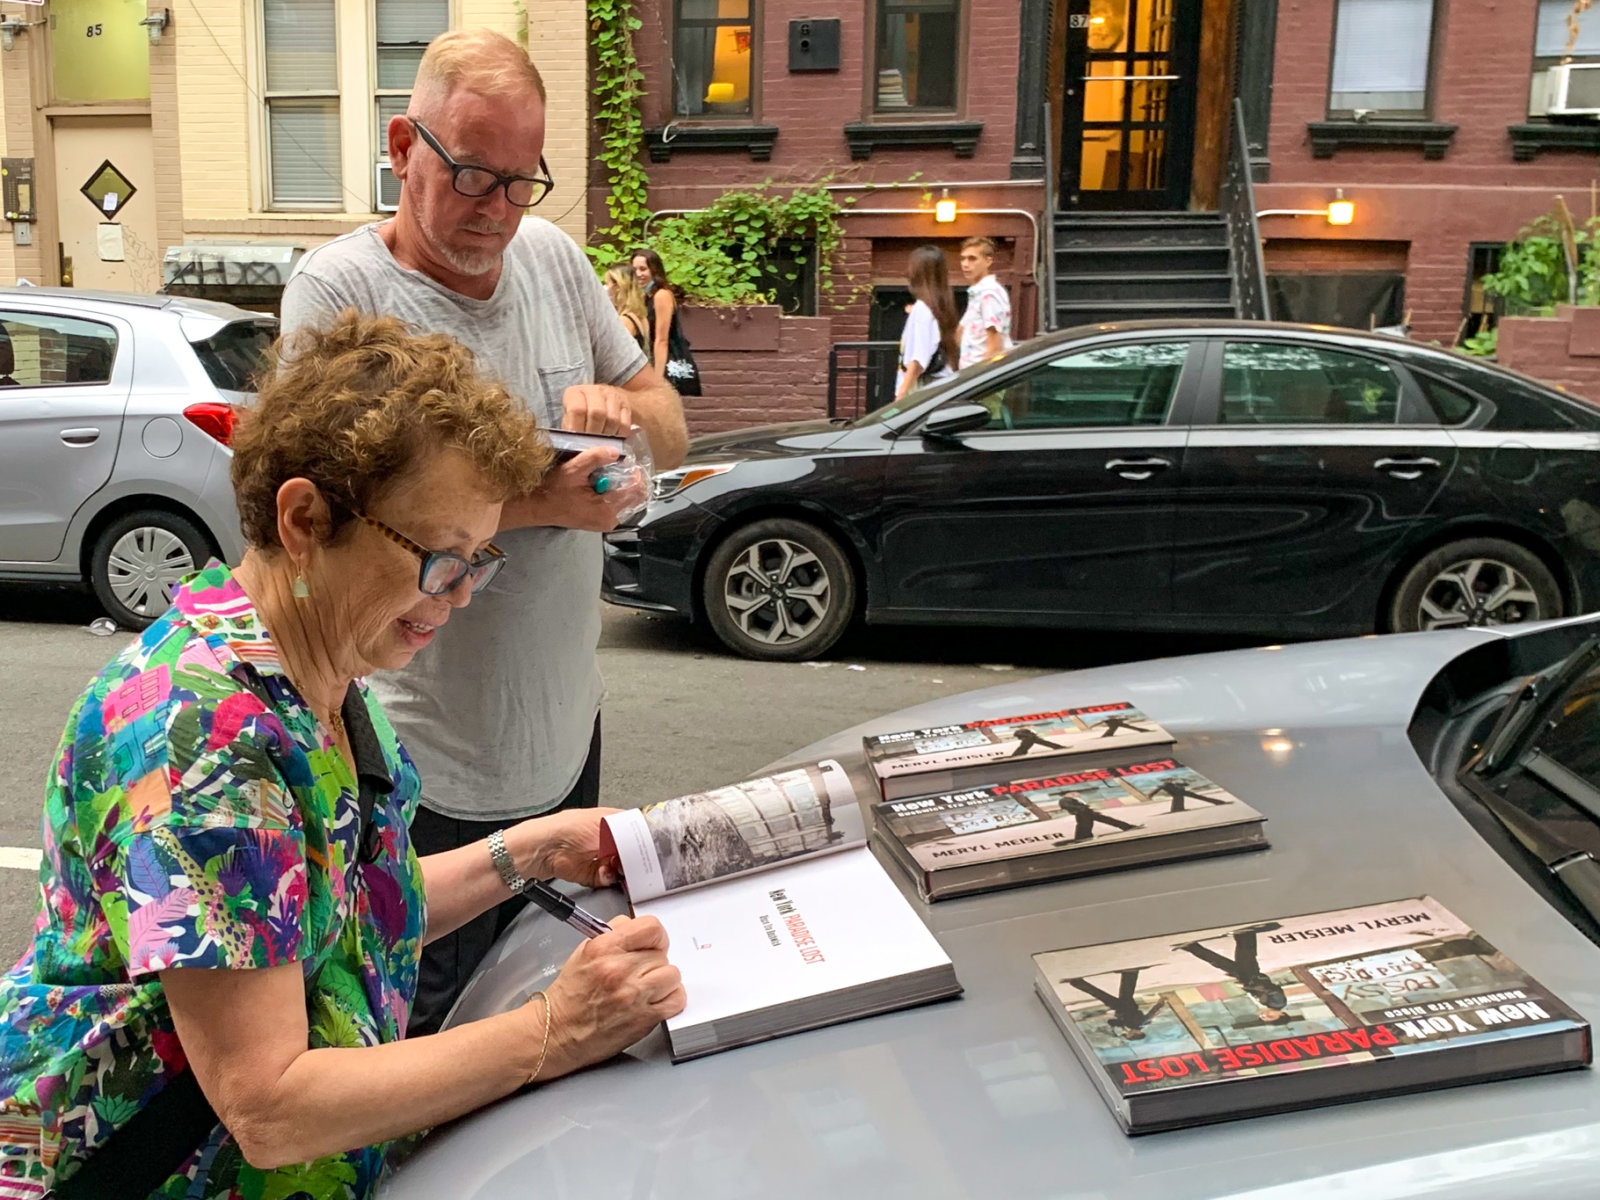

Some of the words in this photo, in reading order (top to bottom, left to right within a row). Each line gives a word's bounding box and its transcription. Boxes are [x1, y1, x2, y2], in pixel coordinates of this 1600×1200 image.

[86, 24, 103, 37] 85
[1071, 15, 1087, 27] 87
[878, 731, 915, 742] New
[921, 726, 962, 736] York
[1077, 703, 1130, 716] LOST
[891, 759, 941, 770] MERYL
[945, 751, 1004, 763] MEISLER
[891, 799, 935, 813] New
[940, 791, 989, 804] York
[992, 769, 1113, 795] PARADISE
[1117, 760, 1177, 777] LOST
[932, 844, 990, 859] MERYL
[995, 832, 1066, 848] MEISLER
[1269, 923, 1355, 944] MEISLER
[1358, 912, 1432, 931] MERYL
[782, 913, 816, 948] PARADISE
[799, 945, 826, 965] LOST
[1344, 976, 1441, 1000] PUSSY
[1454, 990, 1527, 1008] Bushwick
[1384, 1006, 1427, 1018] Disco
[1427, 1003, 1455, 1012] Era
[1475, 1001, 1551, 1026] New
[1394, 1013, 1478, 1039] York
[1212, 1025, 1400, 1069] PARADISE
[1122, 1052, 1210, 1084] LOST
